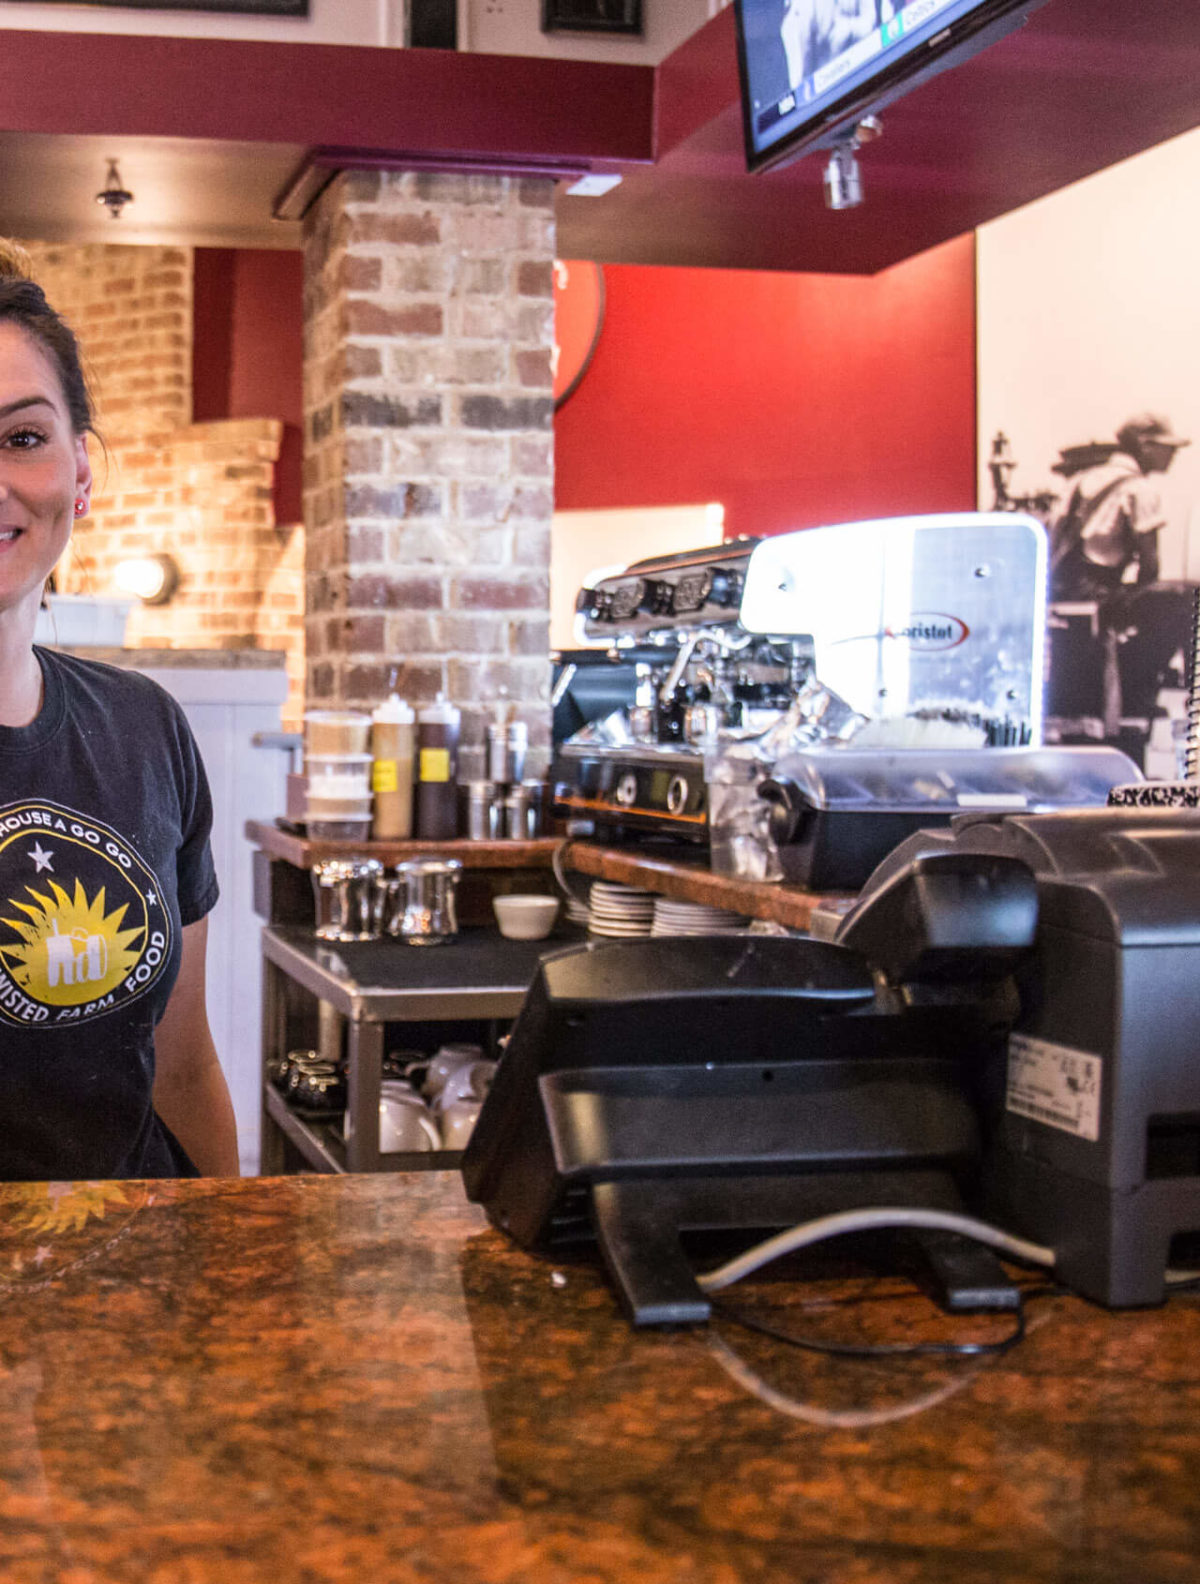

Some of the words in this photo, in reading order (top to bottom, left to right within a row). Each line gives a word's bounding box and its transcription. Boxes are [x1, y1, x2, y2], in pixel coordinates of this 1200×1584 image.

[54, 819, 68, 833] A
[70, 823, 101, 845] GO
[105, 842, 133, 869] GO
[55, 993, 115, 1021] FARM
[125, 931, 166, 993] FOOD
